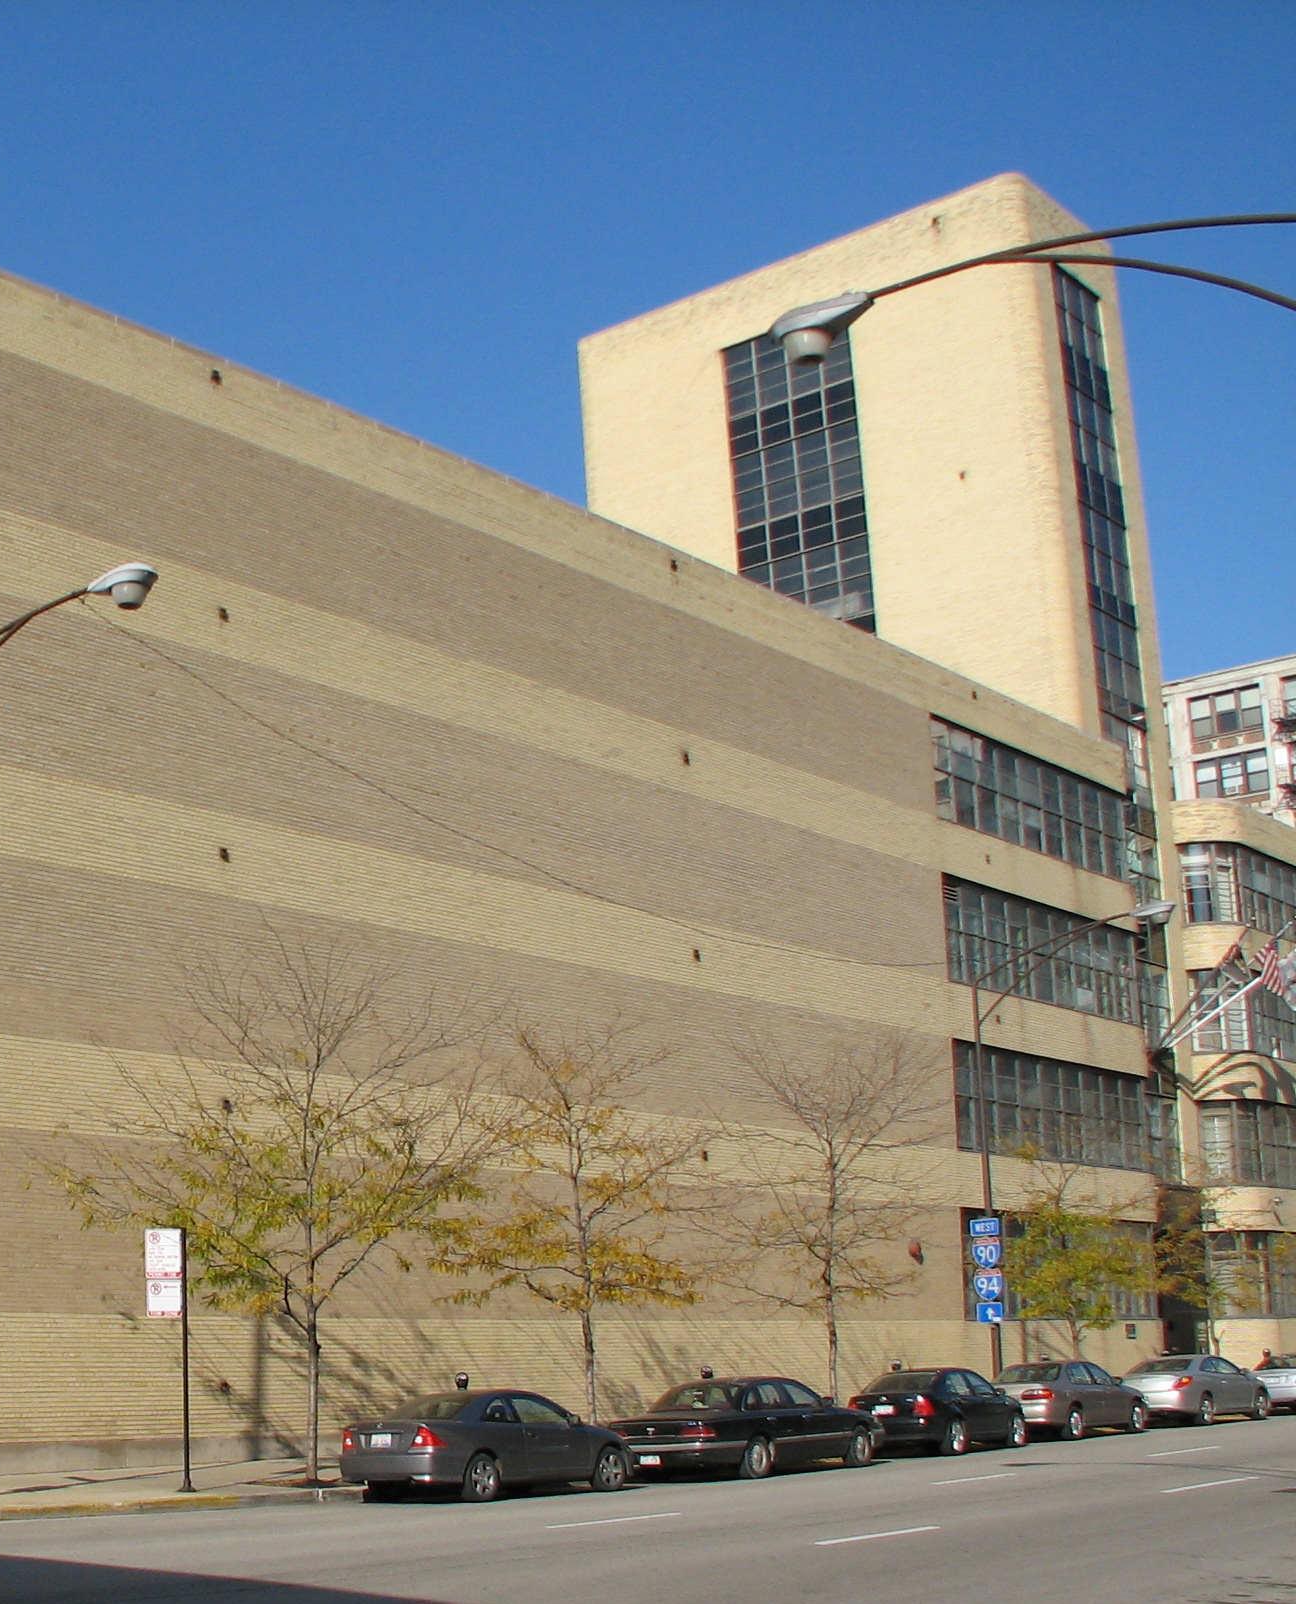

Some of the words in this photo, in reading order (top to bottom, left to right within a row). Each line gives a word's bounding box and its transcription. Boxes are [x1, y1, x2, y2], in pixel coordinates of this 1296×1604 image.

[975, 1222, 994, 1233] WEST
[976, 1245, 996, 1263] 90
[977, 1277, 999, 1295] 94
